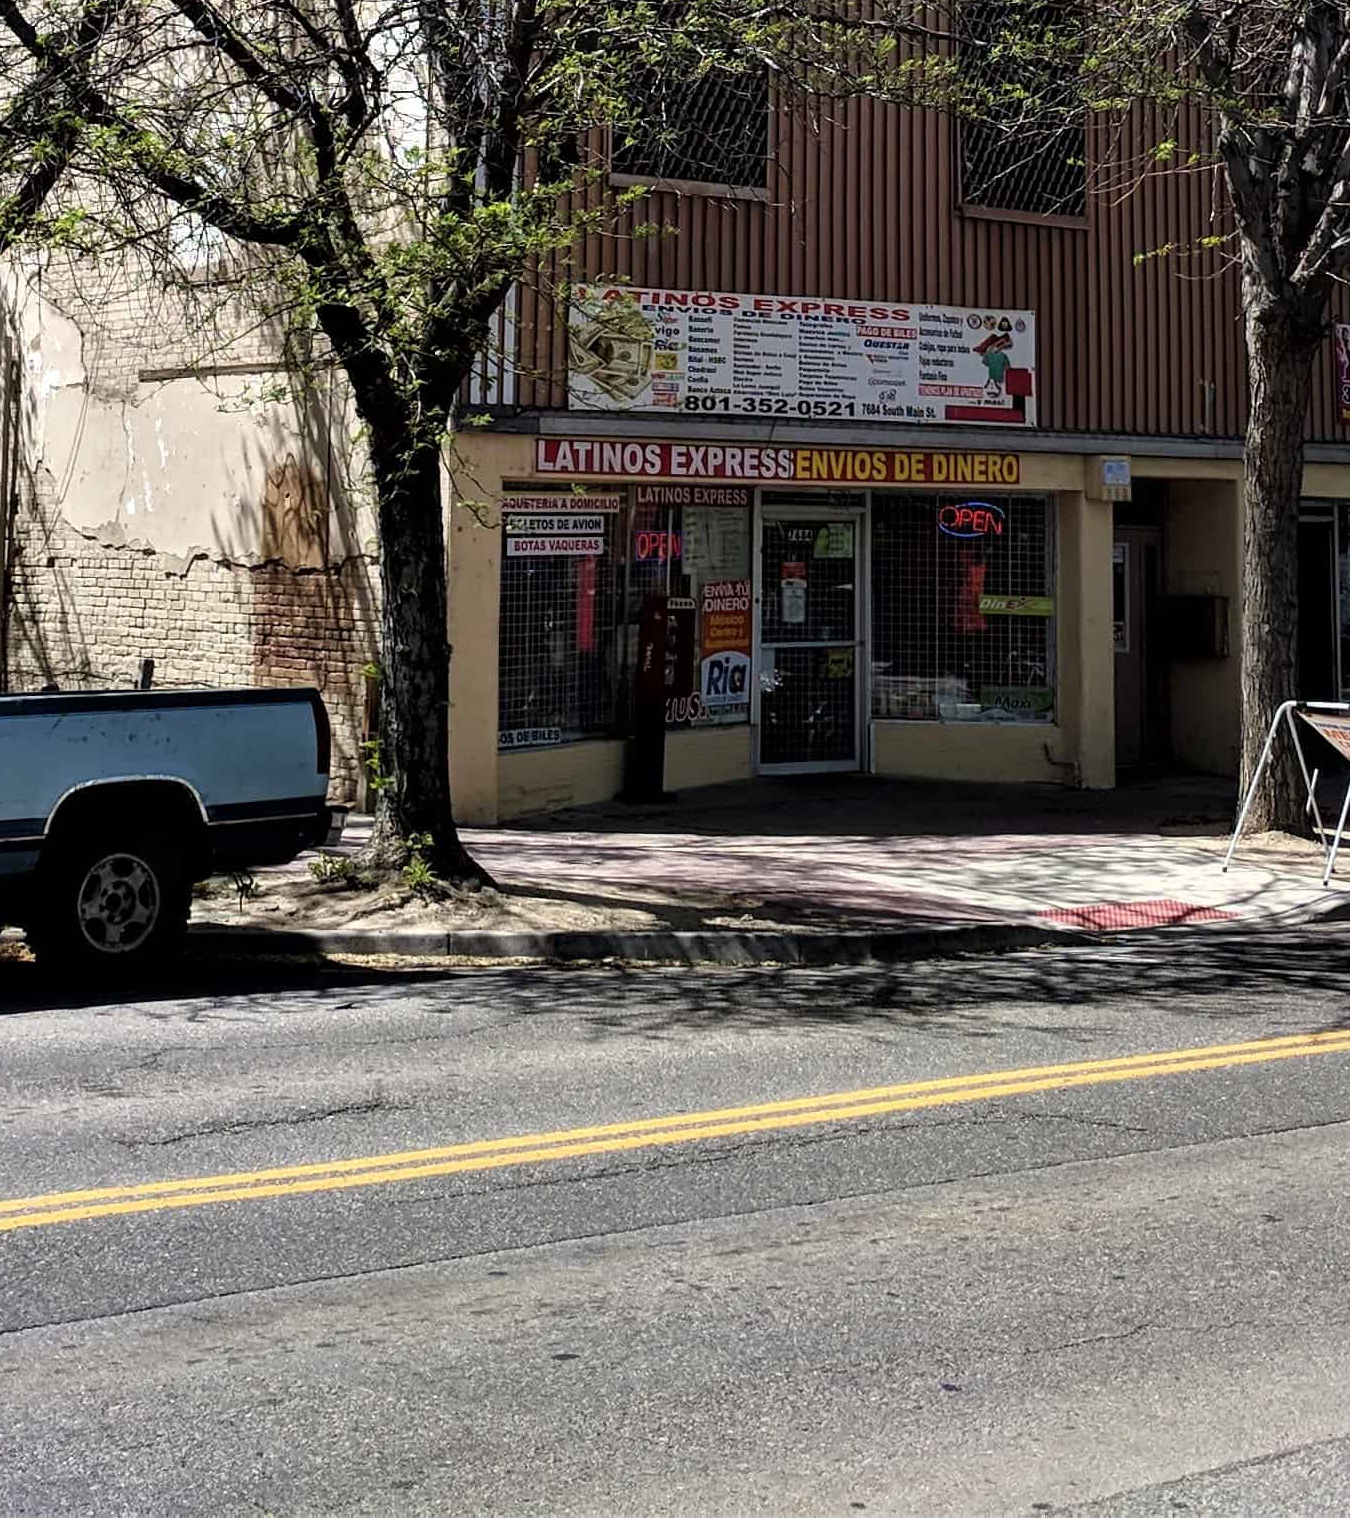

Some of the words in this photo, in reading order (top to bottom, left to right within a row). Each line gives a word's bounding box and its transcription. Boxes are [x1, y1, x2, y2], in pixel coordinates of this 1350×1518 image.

[642, 304, 734, 316] ENVIOS
[742, 310, 772, 319] DE
[780, 313, 868, 325] DINERO
[753, 298, 912, 323] EXPRESS
[654, 325, 680, 338] vigo
[685, 395, 857, 417] 801-352-0521
[861, 402, 881, 415] 7684
[882, 404, 905, 417] South
[906, 404, 924, 417] Main
[537, 439, 661, 475] LATINOS
[670, 445, 794, 478] EXPRESS
[795, 449, 887, 481] ENVIOS
[893, 452, 925, 482] DE
[931, 453, 1019, 483] DINERO
[501, 497, 558, 509] AQUETERIA
[570, 497, 620, 510] DOMICILIO
[637, 486, 692, 504] LATINOS
[693, 488, 748, 506] EXPRESS
[557, 518, 569, 530] DE
[572, 518, 602, 530] AVION
[939, 505, 1003, 535] OPEN
[514, 539, 547, 552] BOTAS
[548, 538, 600, 551] VAQUERAS
[638, 532, 683, 562] OPEN
[704, 596, 750, 612] DINERO
[706, 656, 749, 696] Ria
[516, 731, 529, 743] DE
[531, 729, 561, 741] BILES
